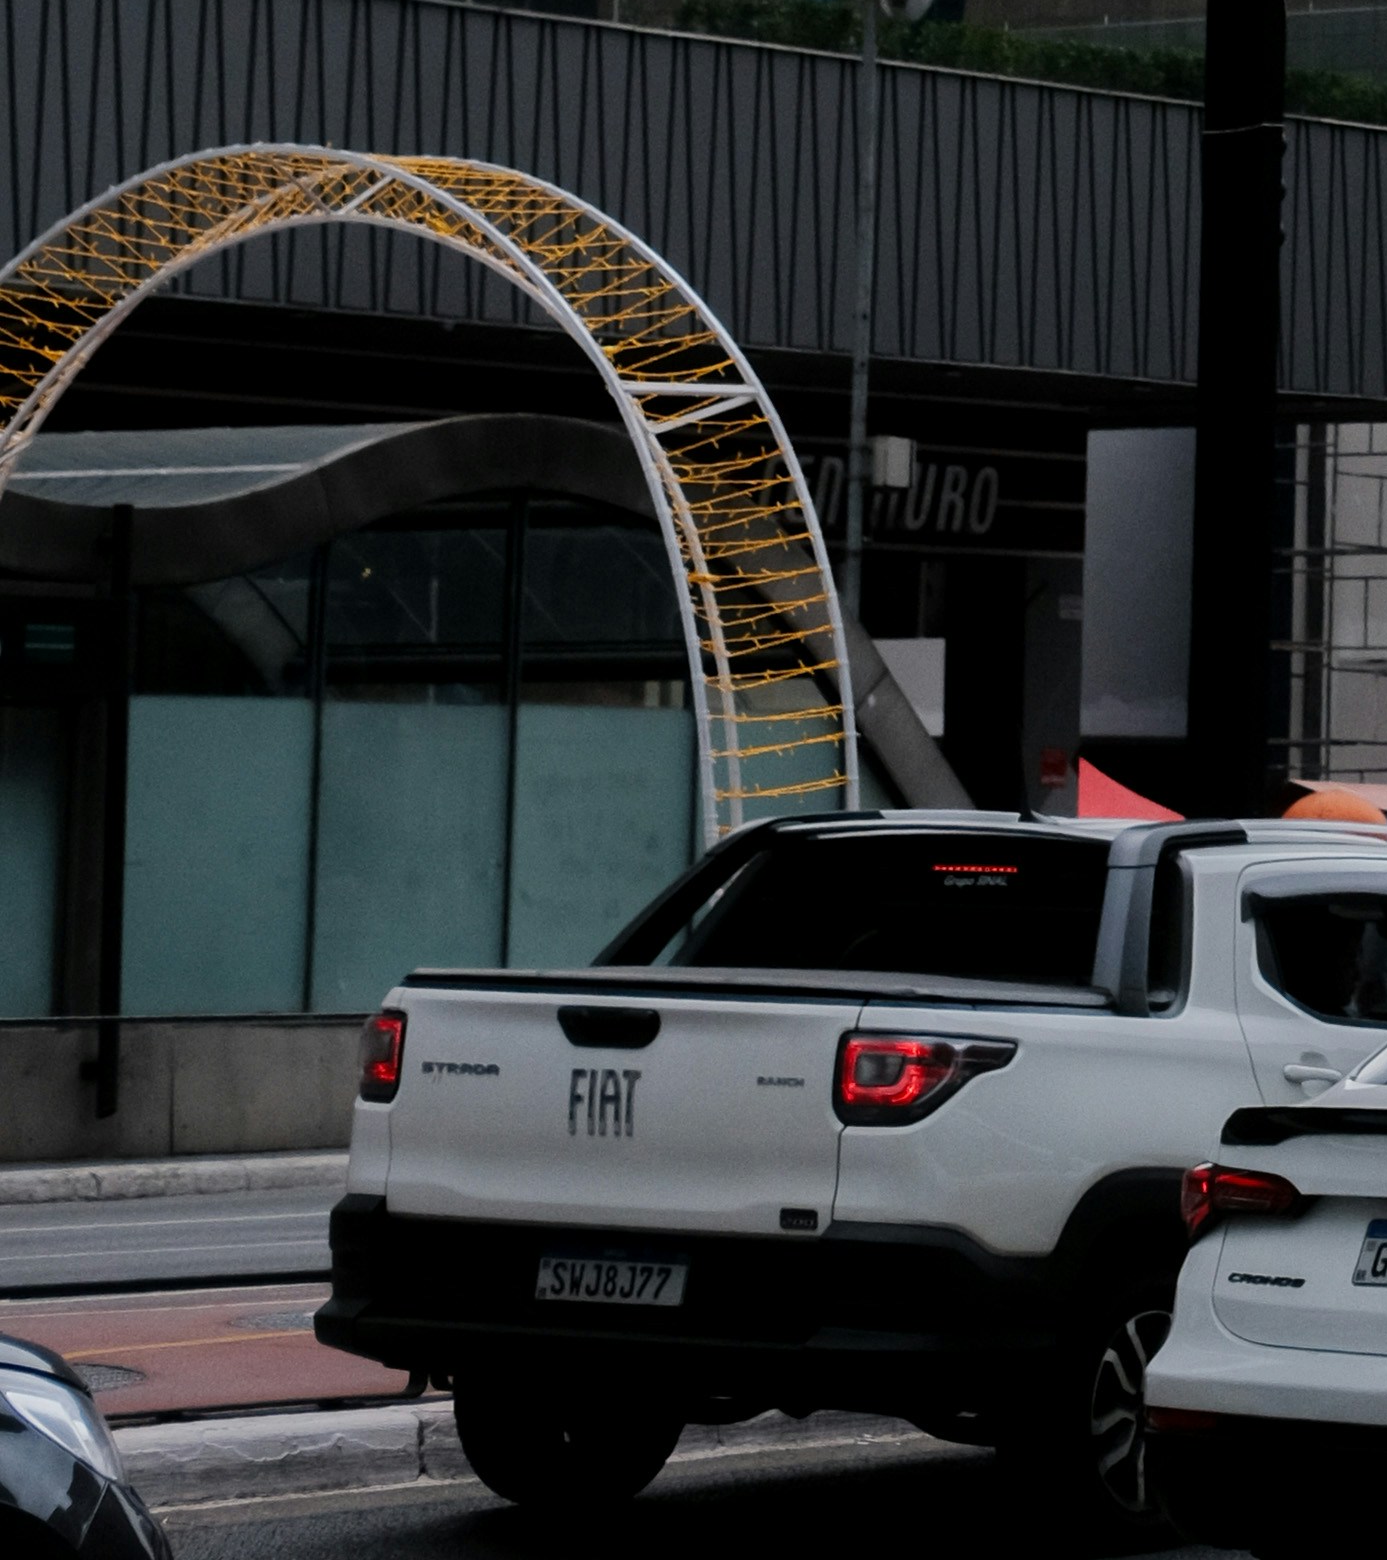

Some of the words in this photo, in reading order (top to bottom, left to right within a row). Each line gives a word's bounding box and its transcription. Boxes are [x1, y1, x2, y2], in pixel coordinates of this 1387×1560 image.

[421, 1060, 500, 1077] STRADA
[756, 1075, 805, 1088] RANCH
[567, 1068, 642, 1138] FIAT
[549, 1261, 672, 1300] SWJ8J77
